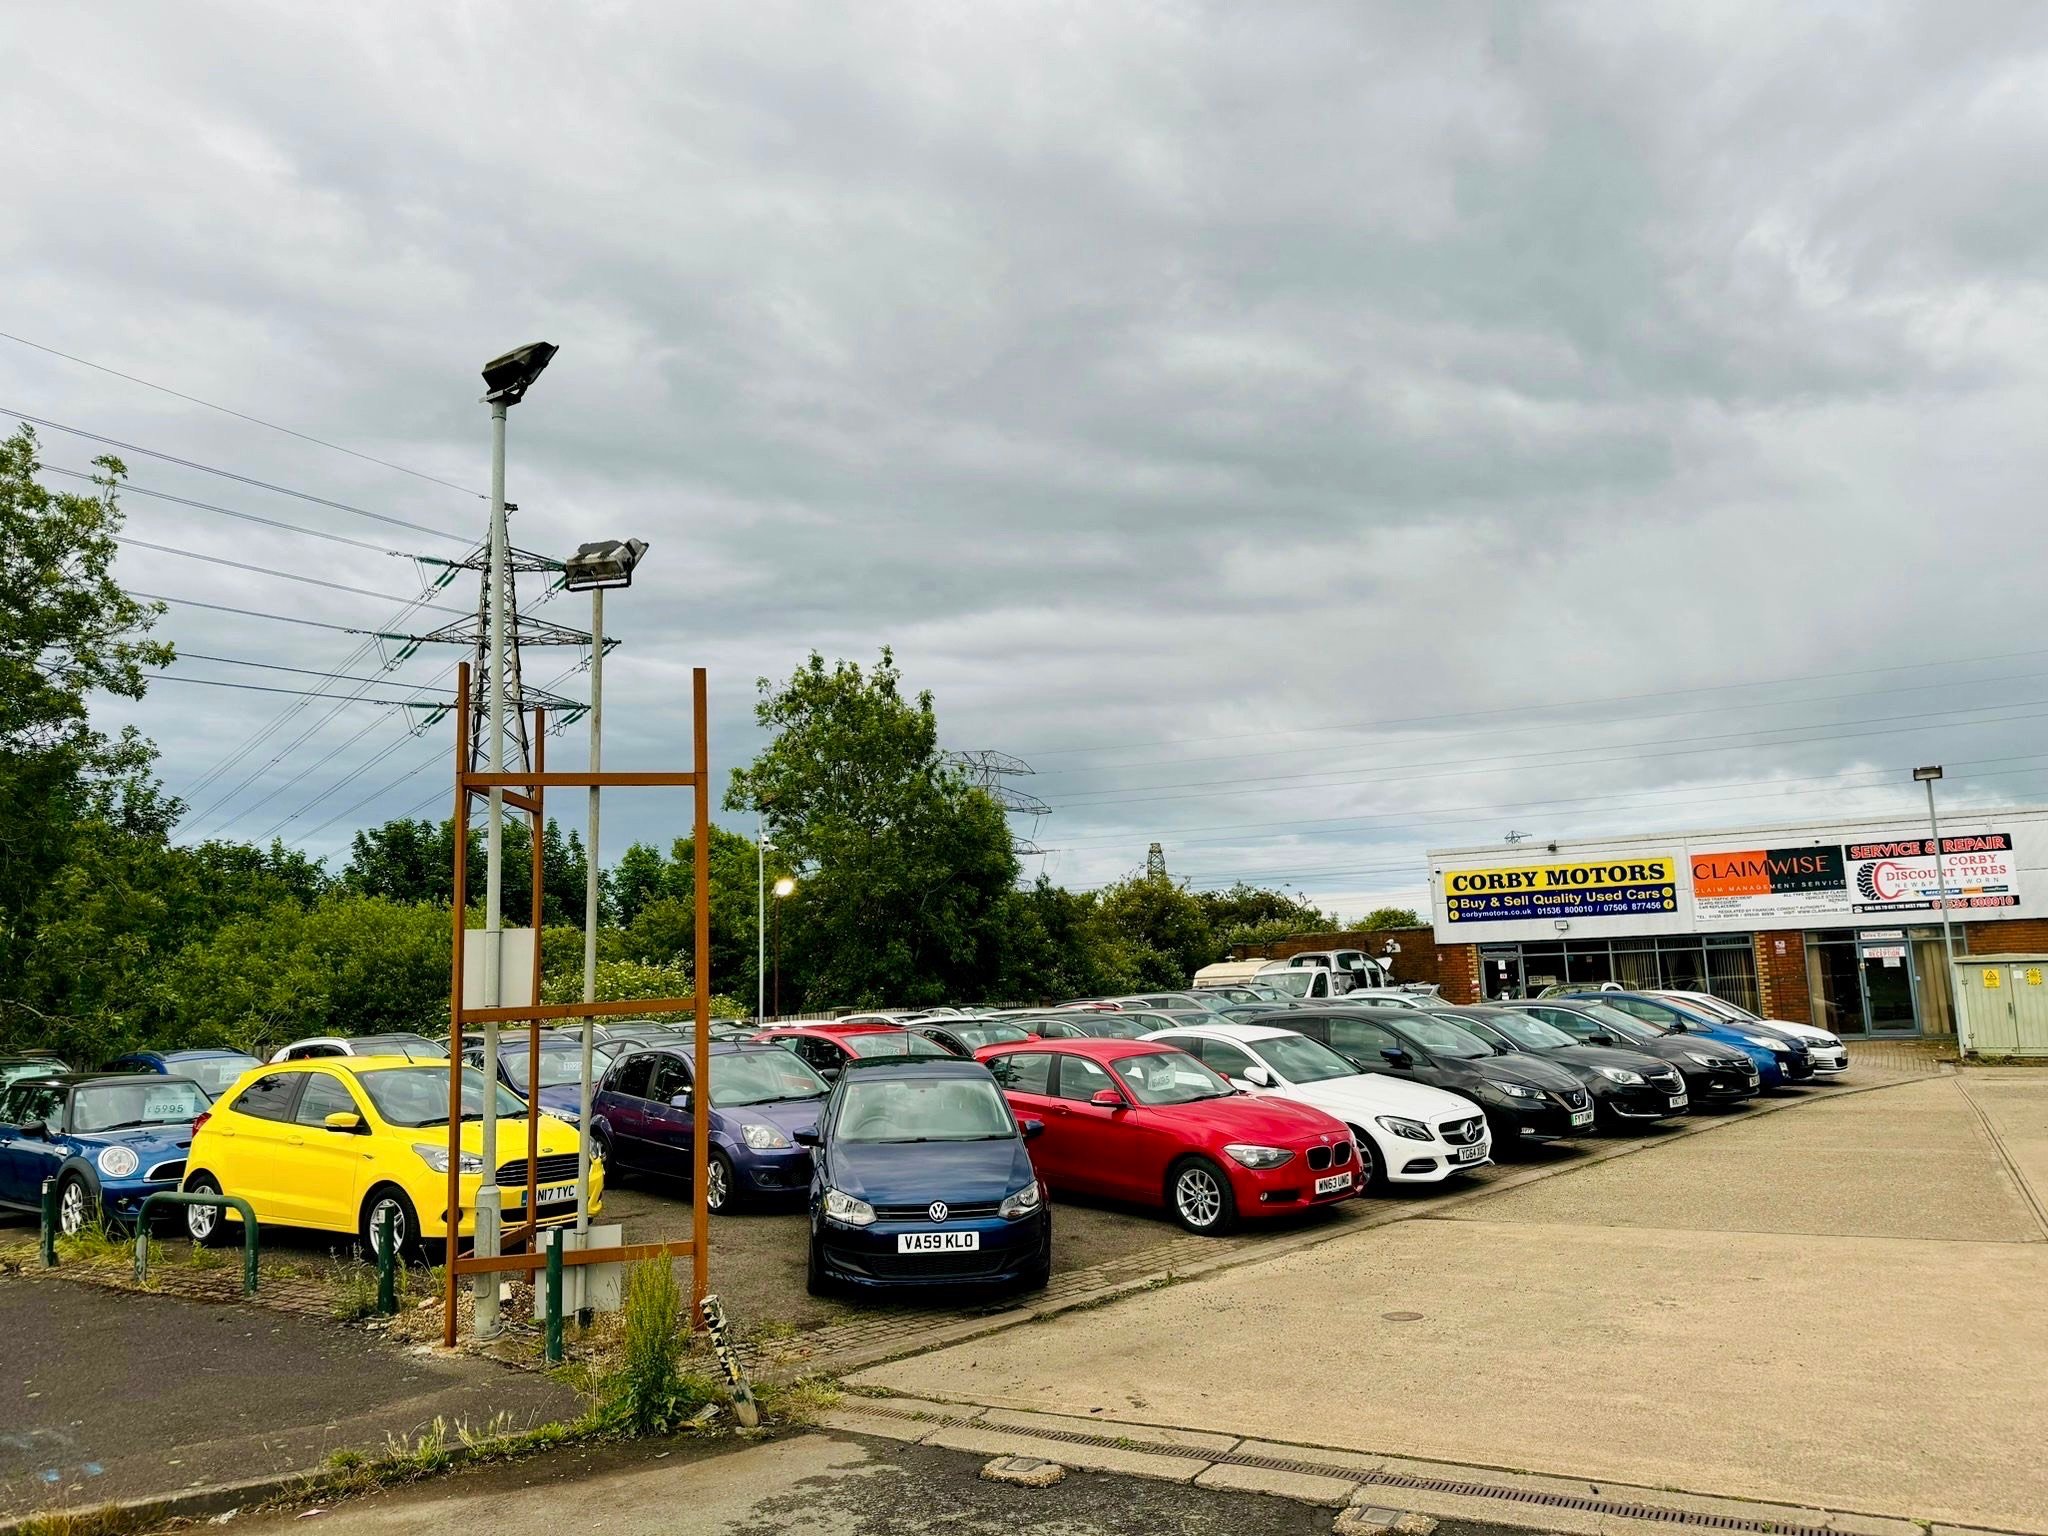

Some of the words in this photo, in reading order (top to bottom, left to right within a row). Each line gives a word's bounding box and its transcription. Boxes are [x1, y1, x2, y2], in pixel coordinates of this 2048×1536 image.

[1850, 841, 1921, 859] SERVICE
[1924, 840, 1936, 854] &
[1942, 836, 2006, 853] REPAIR
[1693, 855, 1830, 880] CLAIMWISE
[1948, 854, 1998, 866] CORBY
[1452, 871, 1538, 892] CORBY
[1546, 863, 1665, 886] MOTORS
[1959, 865, 2007, 876] TYRES
[1728, 882, 1796, 892] MANAGEMENT
[1801, 879, 1846, 888] SERVICE
[1460, 898, 1487, 910] Buy
[1490, 897, 1500, 908] &
[1504, 895, 1529, 906] Sell
[1533, 892, 1582, 906] Quality
[1586, 890, 1622, 902] Used
[1626, 888, 1660, 900] Cars
[1931, 898, 1968, 910] 0536
[1970, 896, 2014, 908] 800010
[1461, 908, 1532, 919] corbymotors.co.uk
[1537, 906, 1561, 915] 01536
[1564, 904, 1593, 914] 800010
[1603, 903, 1628, 912] 07506
[1631, 901, 1661, 910] 877456
[1461, 1148, 1476, 1161] YG64
[556, 1185, 575, 1199] TYC
[1318, 1177, 1338, 1192] WN63
[904, 1234, 942, 1250] VA59
[945, 1233, 973, 1249] KLO
